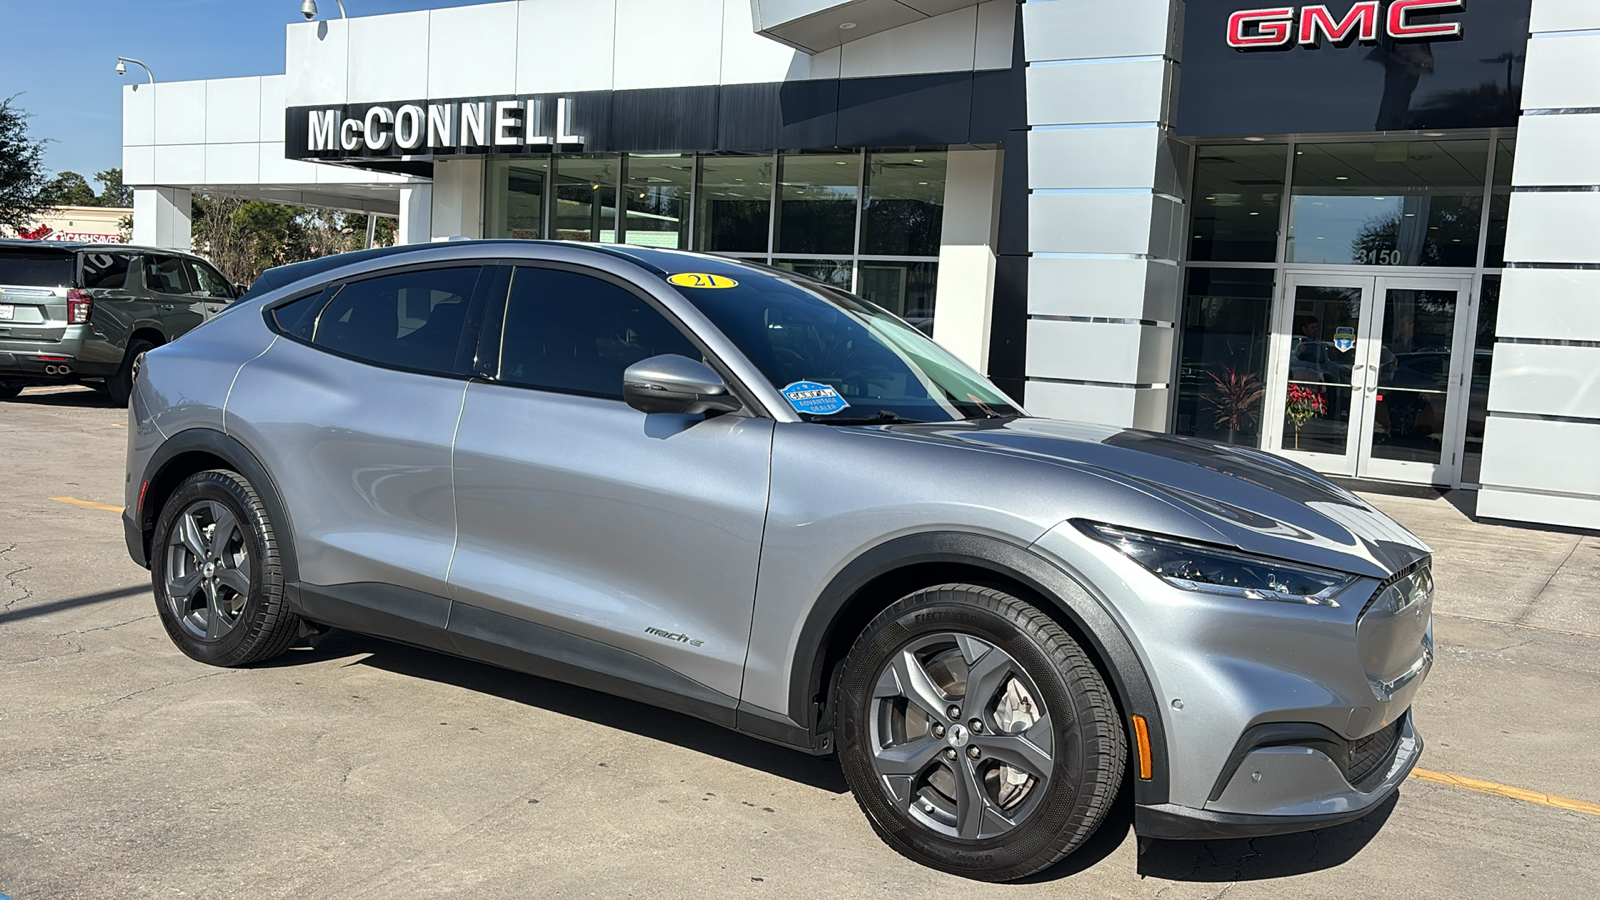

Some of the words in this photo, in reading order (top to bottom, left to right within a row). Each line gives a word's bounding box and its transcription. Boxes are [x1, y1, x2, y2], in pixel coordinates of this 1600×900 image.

[1227, 0, 1463, 47] GMC
[307, 98, 584, 151] McCONNELL
[1358, 249, 1401, 265] 3150
[688, 274, 720, 286] 21
[799, 397, 838, 407] ADVANTAGE
[810, 404, 837, 412] DEALER
